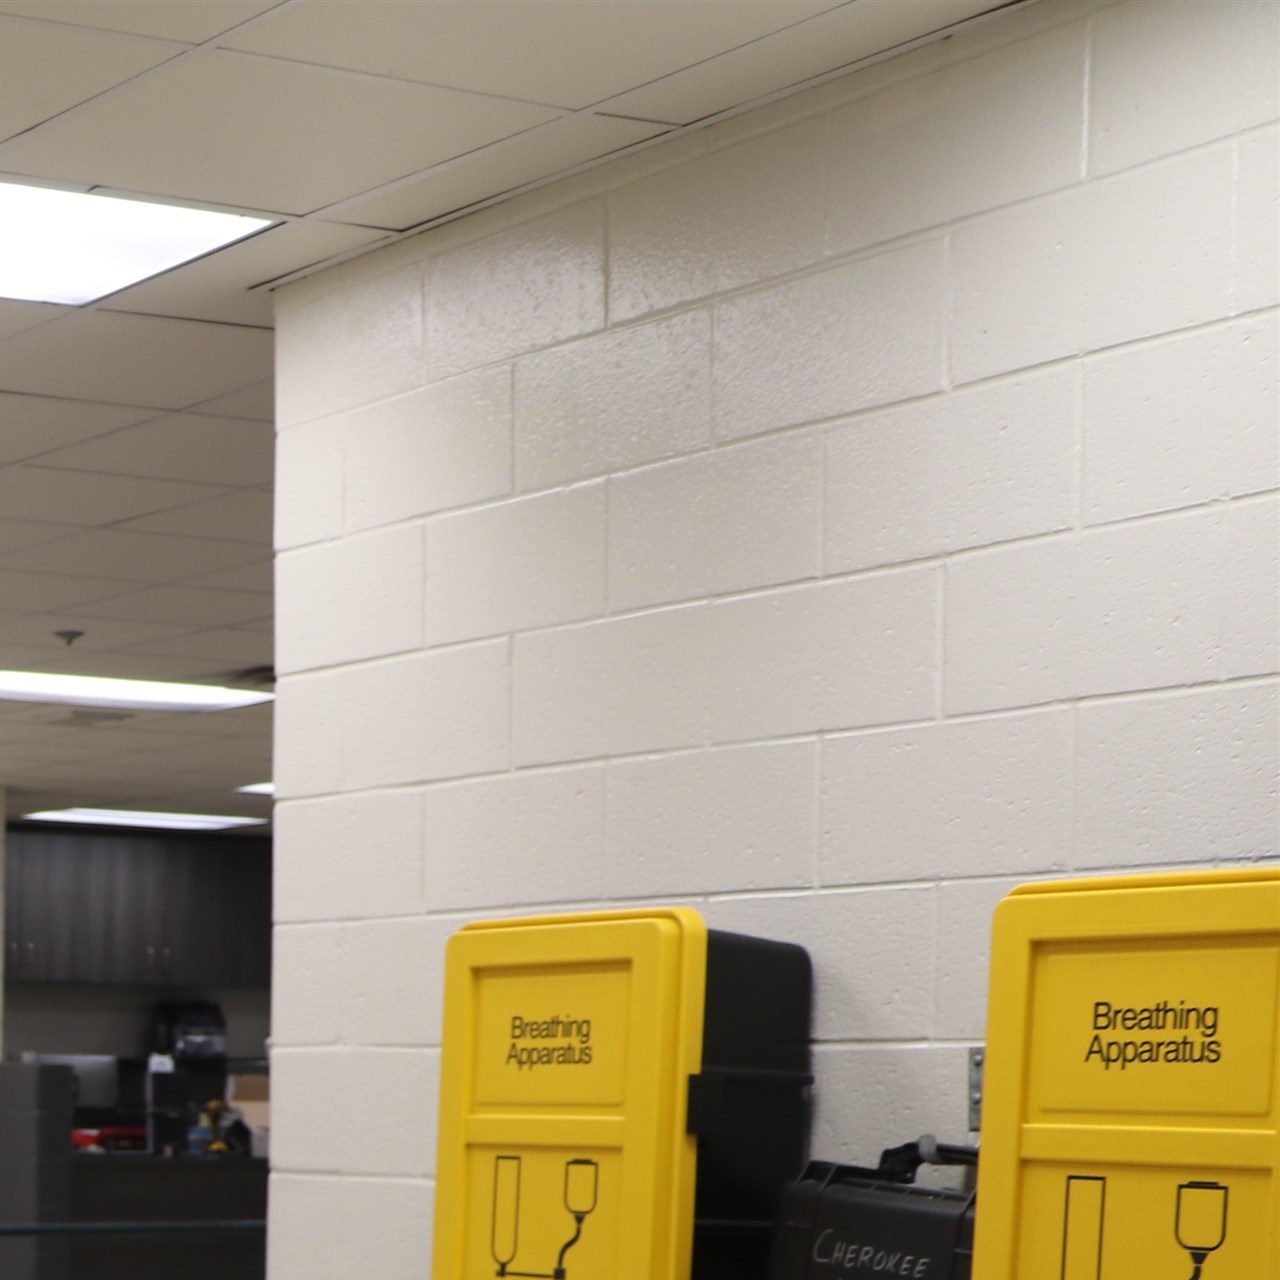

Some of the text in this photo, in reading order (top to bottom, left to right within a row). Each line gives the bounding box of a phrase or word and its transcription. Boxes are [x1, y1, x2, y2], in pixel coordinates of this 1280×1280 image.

[510, 1014, 591, 1044] Breathing
[1092, 1000, 1218, 1037] Breathing
[505, 1042, 593, 1071] Apparatus
[1085, 1034, 1222, 1070] Apparatus
[812, 1229, 930, 1278] CHEROKEE
